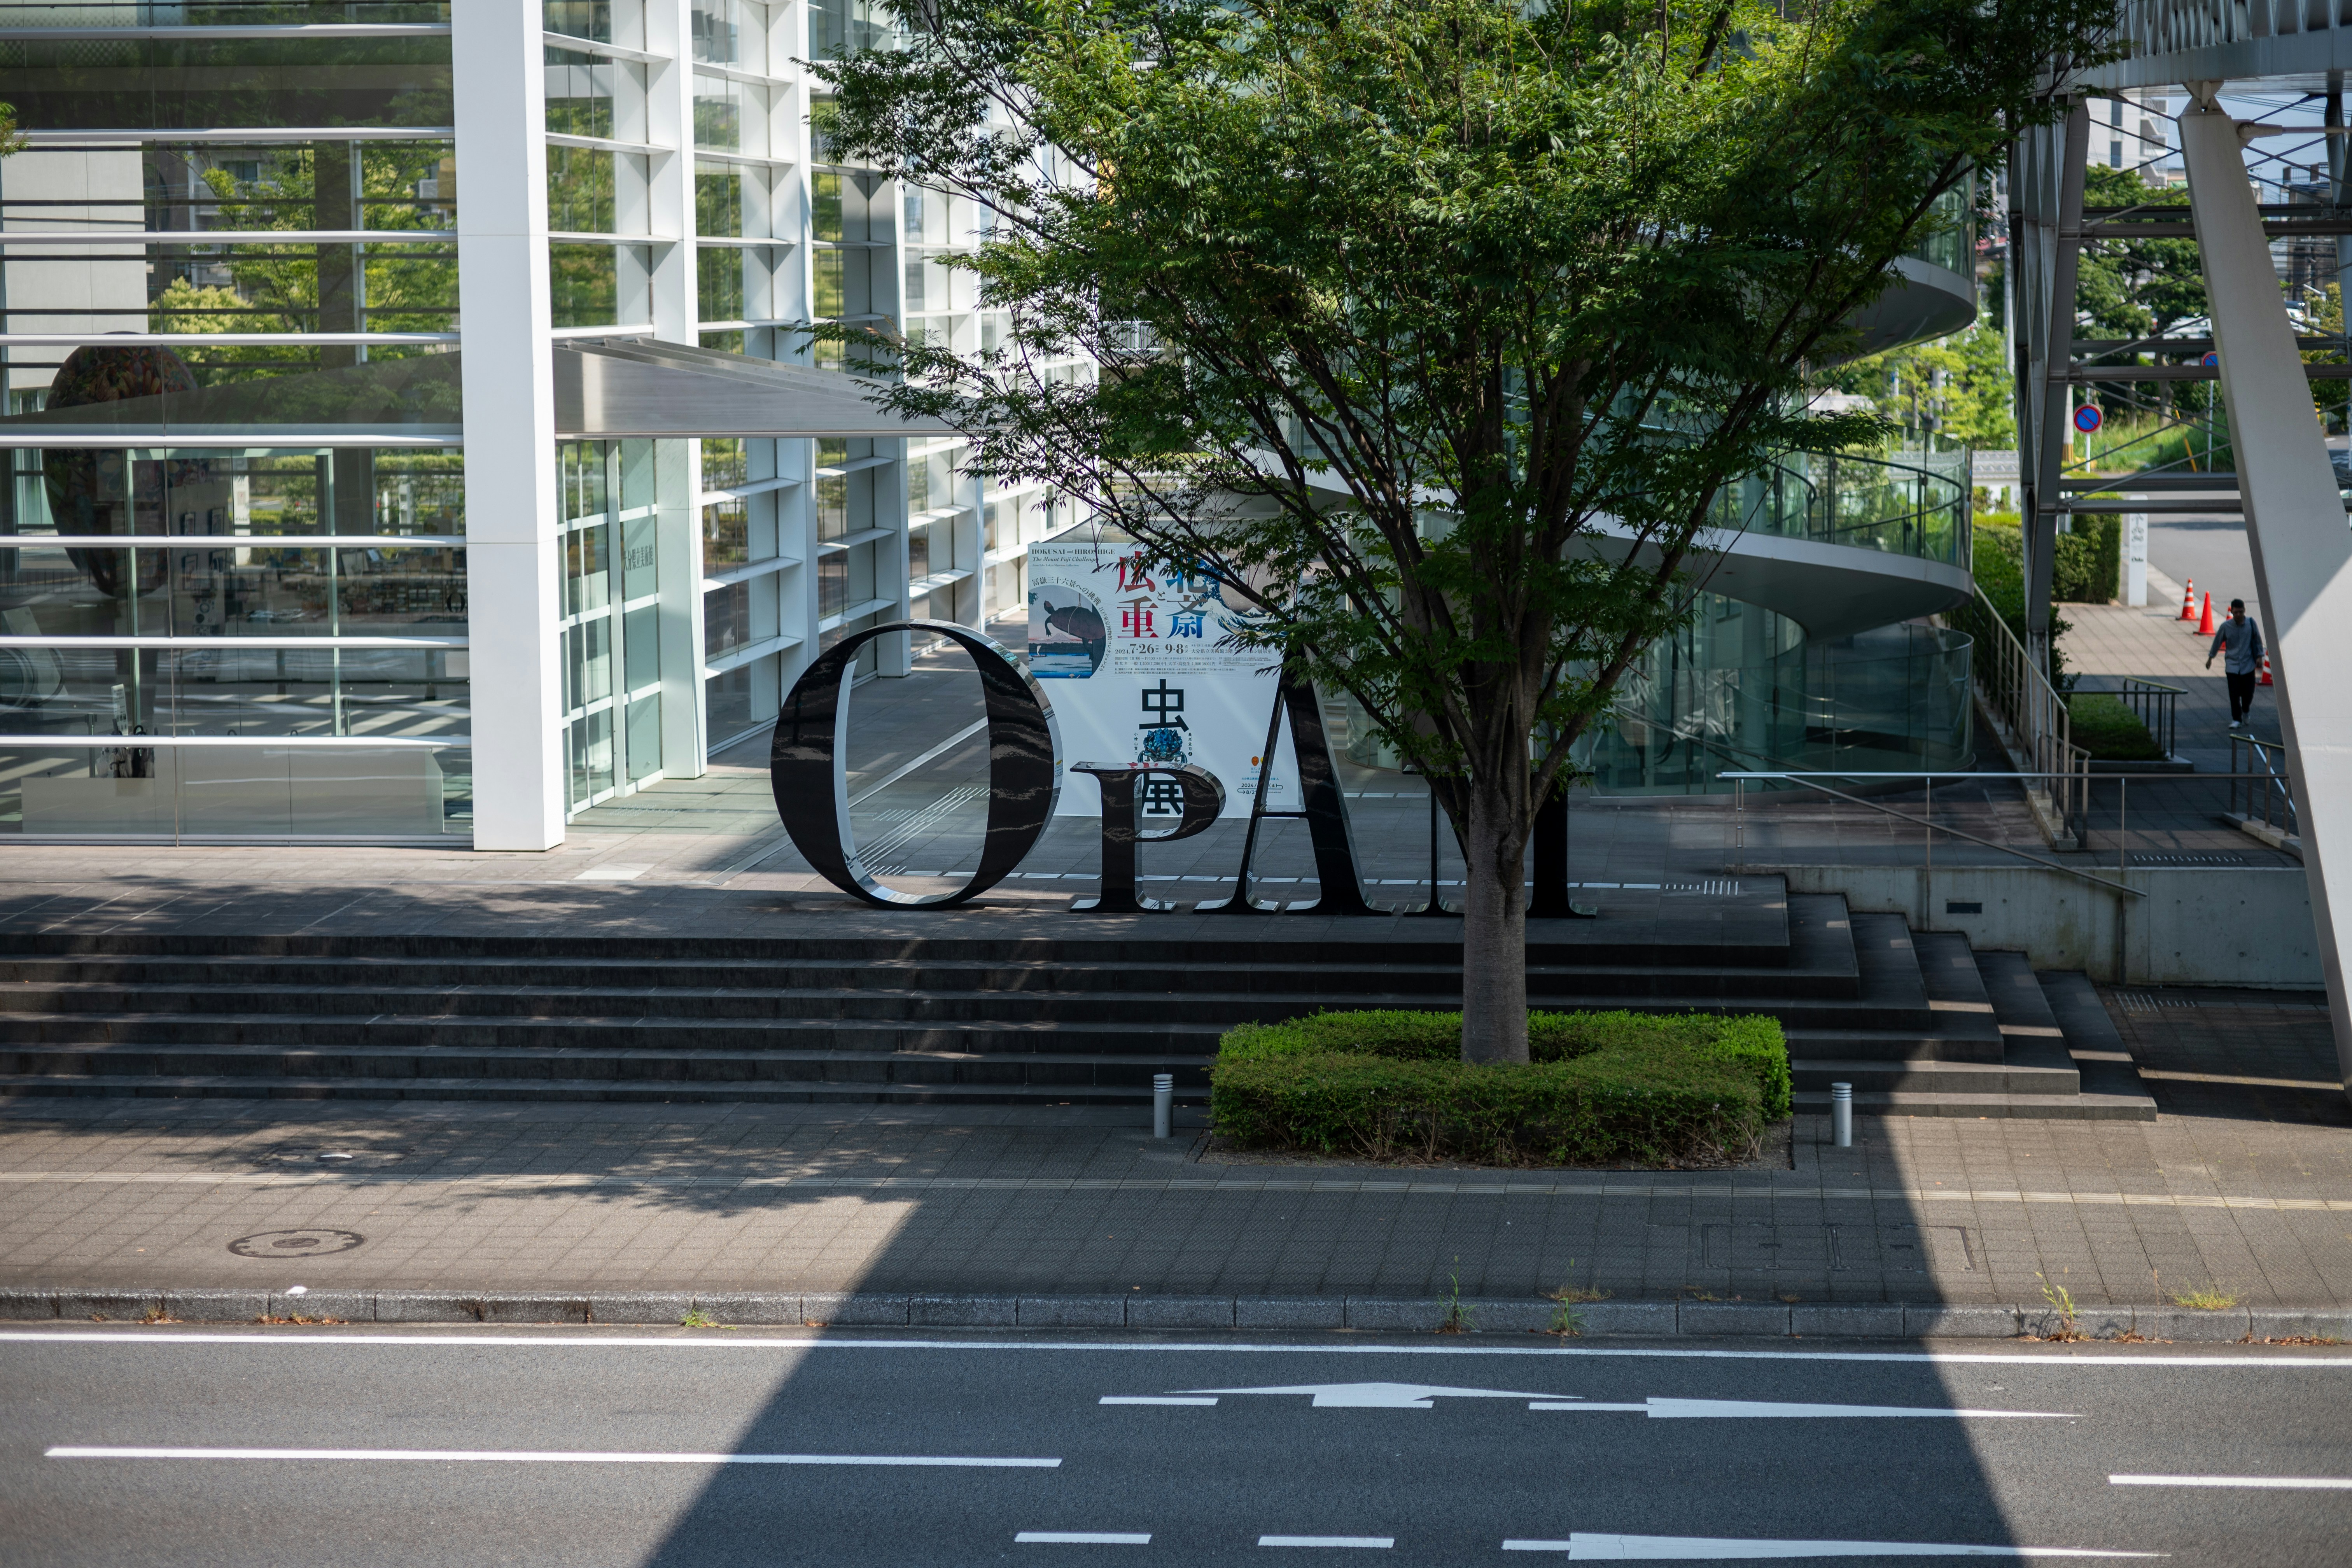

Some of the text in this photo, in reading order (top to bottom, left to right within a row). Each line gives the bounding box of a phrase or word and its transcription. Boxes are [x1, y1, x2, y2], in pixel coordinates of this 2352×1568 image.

[623, 544, 653, 571] 大分県立美術館
[1157, 591, 1166, 601] と
